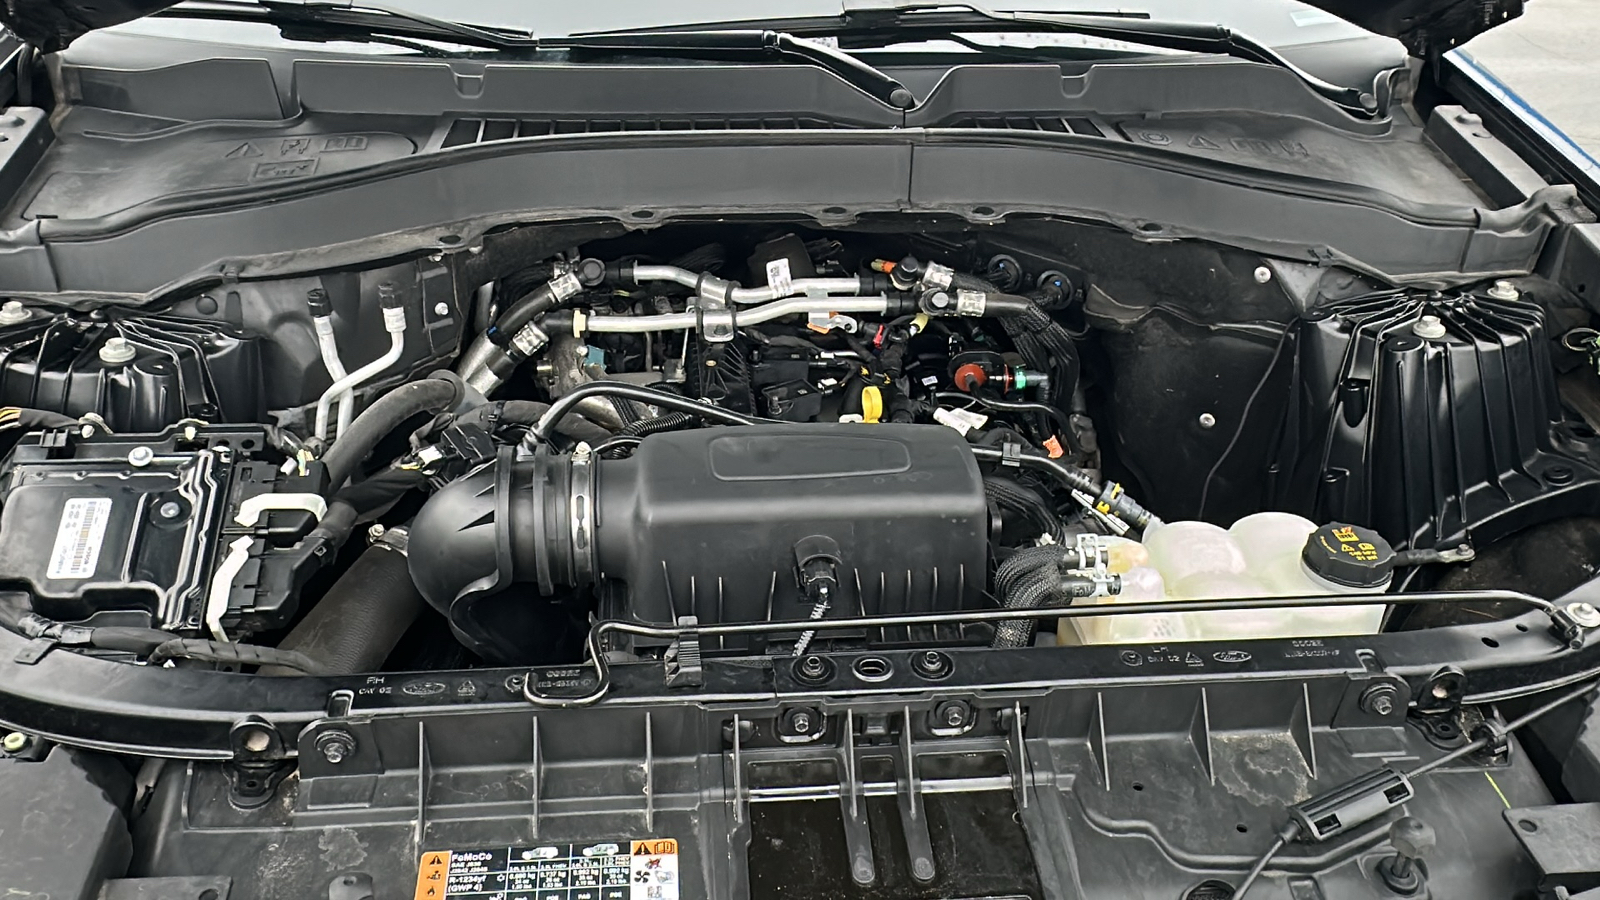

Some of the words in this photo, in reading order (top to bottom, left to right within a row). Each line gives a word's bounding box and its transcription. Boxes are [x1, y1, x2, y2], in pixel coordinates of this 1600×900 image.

[451, 852, 493, 862] FoMoCo
[448, 875, 487, 884] R-1234yf
[448, 884, 473, 893] (GWP
[473, 883, 483, 892] 4)
